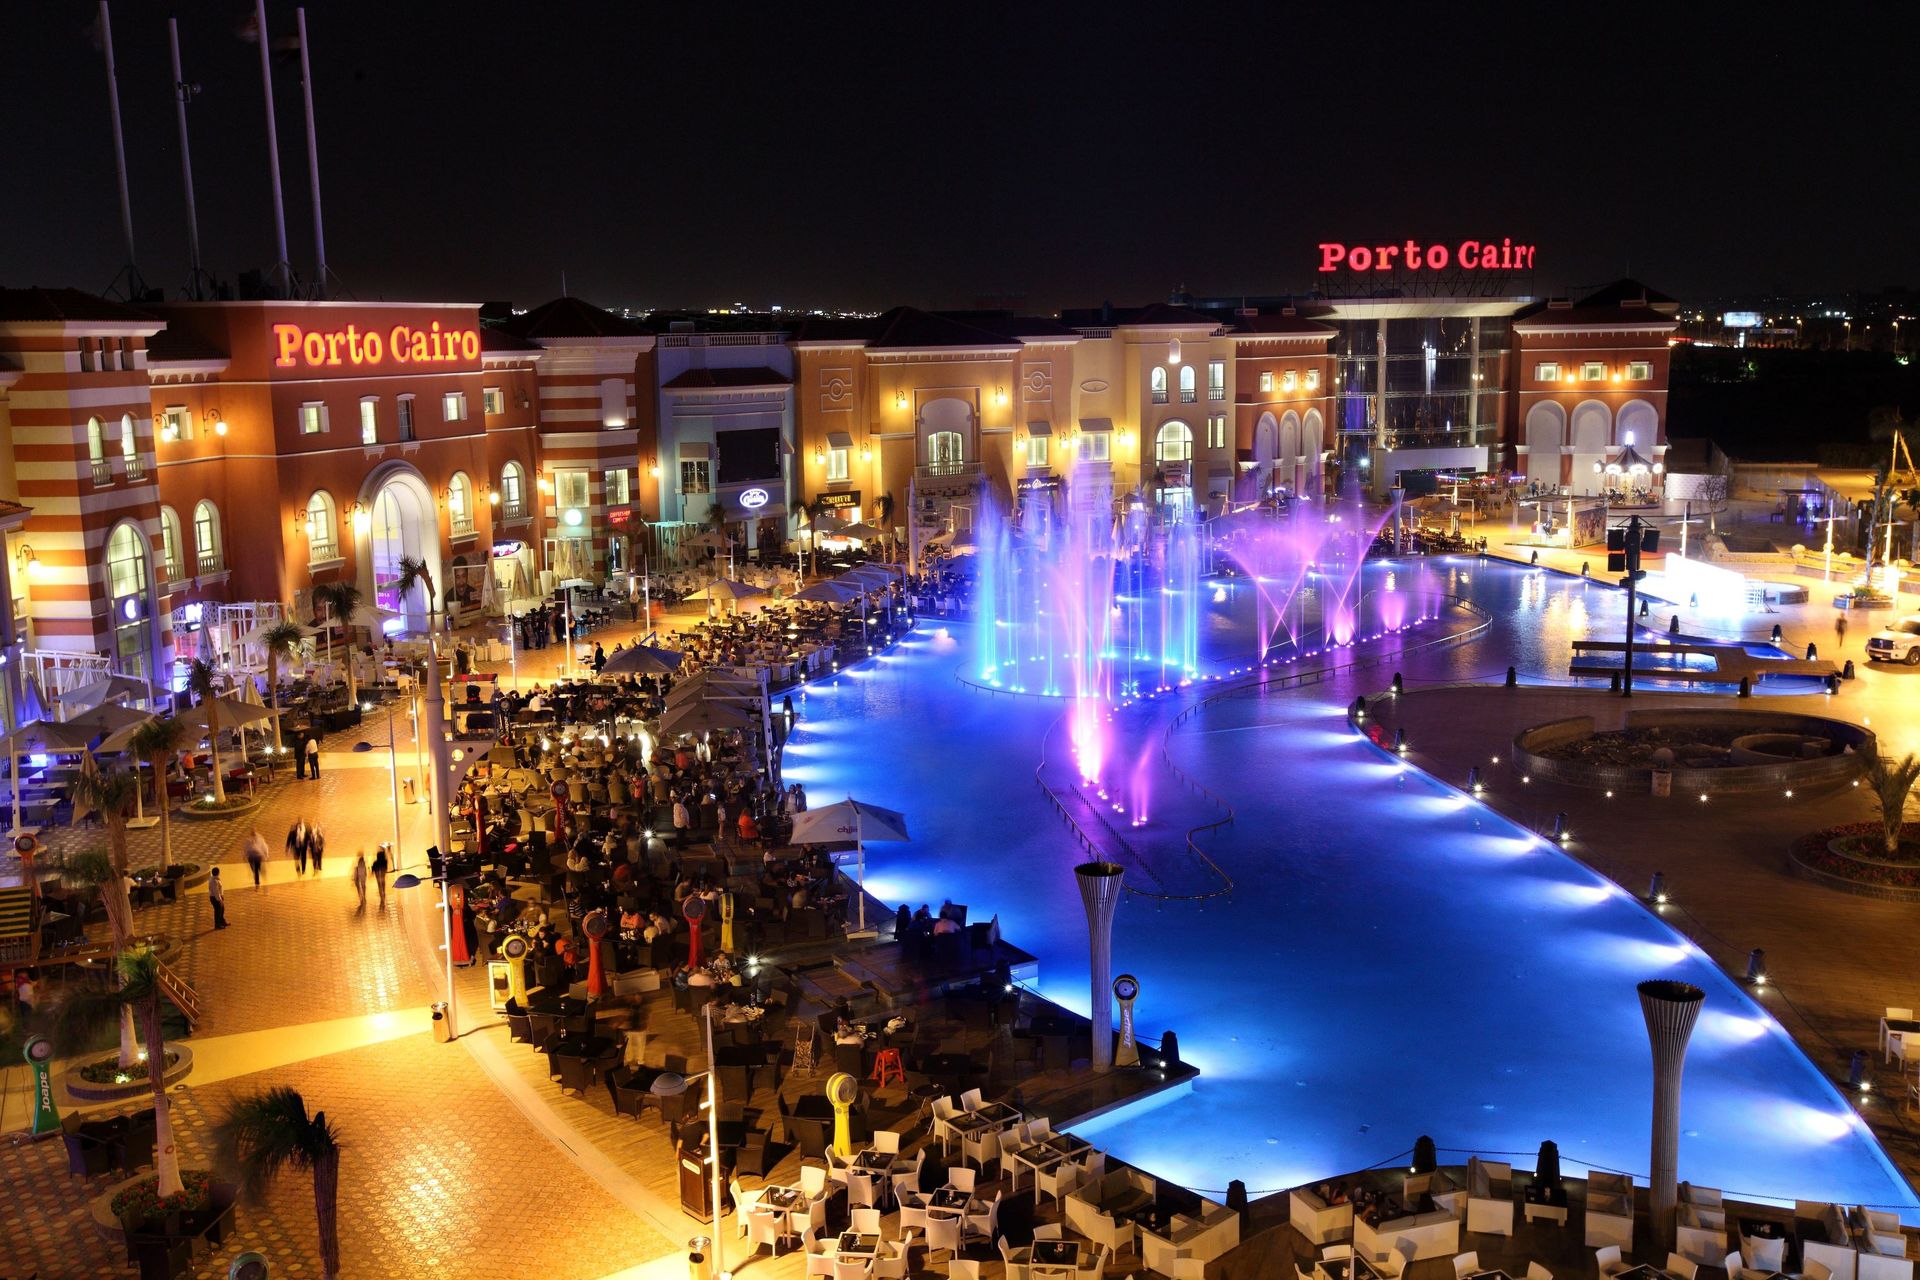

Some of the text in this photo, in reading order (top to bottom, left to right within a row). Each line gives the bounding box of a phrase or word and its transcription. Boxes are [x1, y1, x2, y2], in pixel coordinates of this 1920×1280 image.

[1318, 240, 1449, 272] Porto
[273, 320, 479, 367] Porto Cairo
[40, 1071, 51, 1113] Joape
